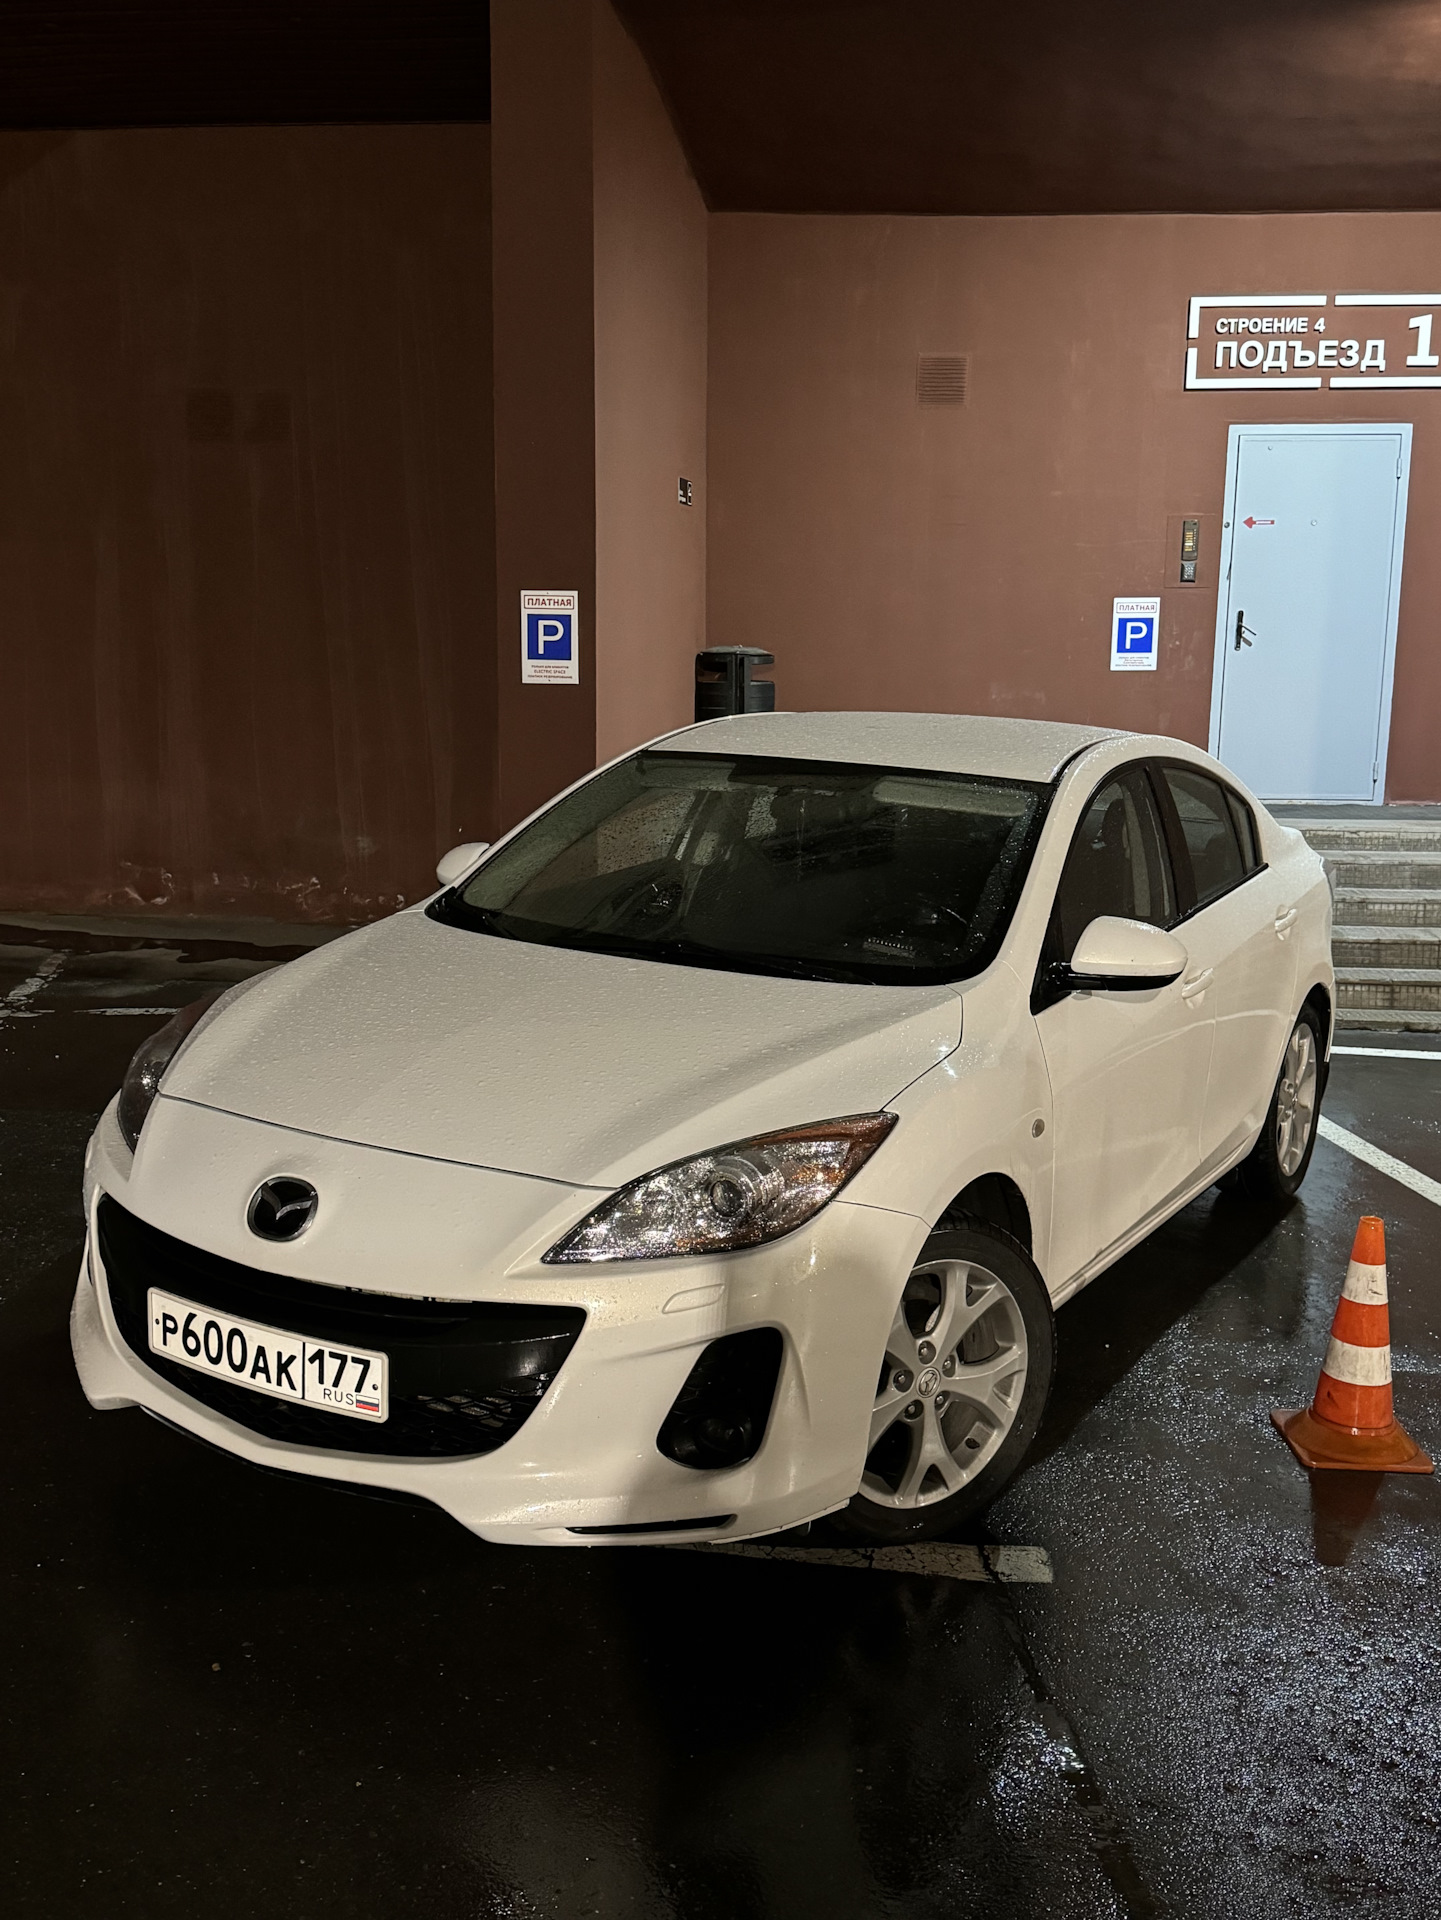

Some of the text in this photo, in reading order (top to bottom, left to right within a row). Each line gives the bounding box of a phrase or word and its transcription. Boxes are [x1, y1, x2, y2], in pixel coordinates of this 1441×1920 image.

[1215, 317, 1326, 334] СТРОЕНИЕ 4
[1215, 313, 1440, 373] ПОДЪЕЗД 1
[527, 597, 572, 607] ПЛАТНАЯ
[537, 619, 564, 655] P
[1125, 621, 1148, 650] P
[161, 1311, 372, 1394] Р600АК 177
[323, 1388, 355, 1406] RUS
